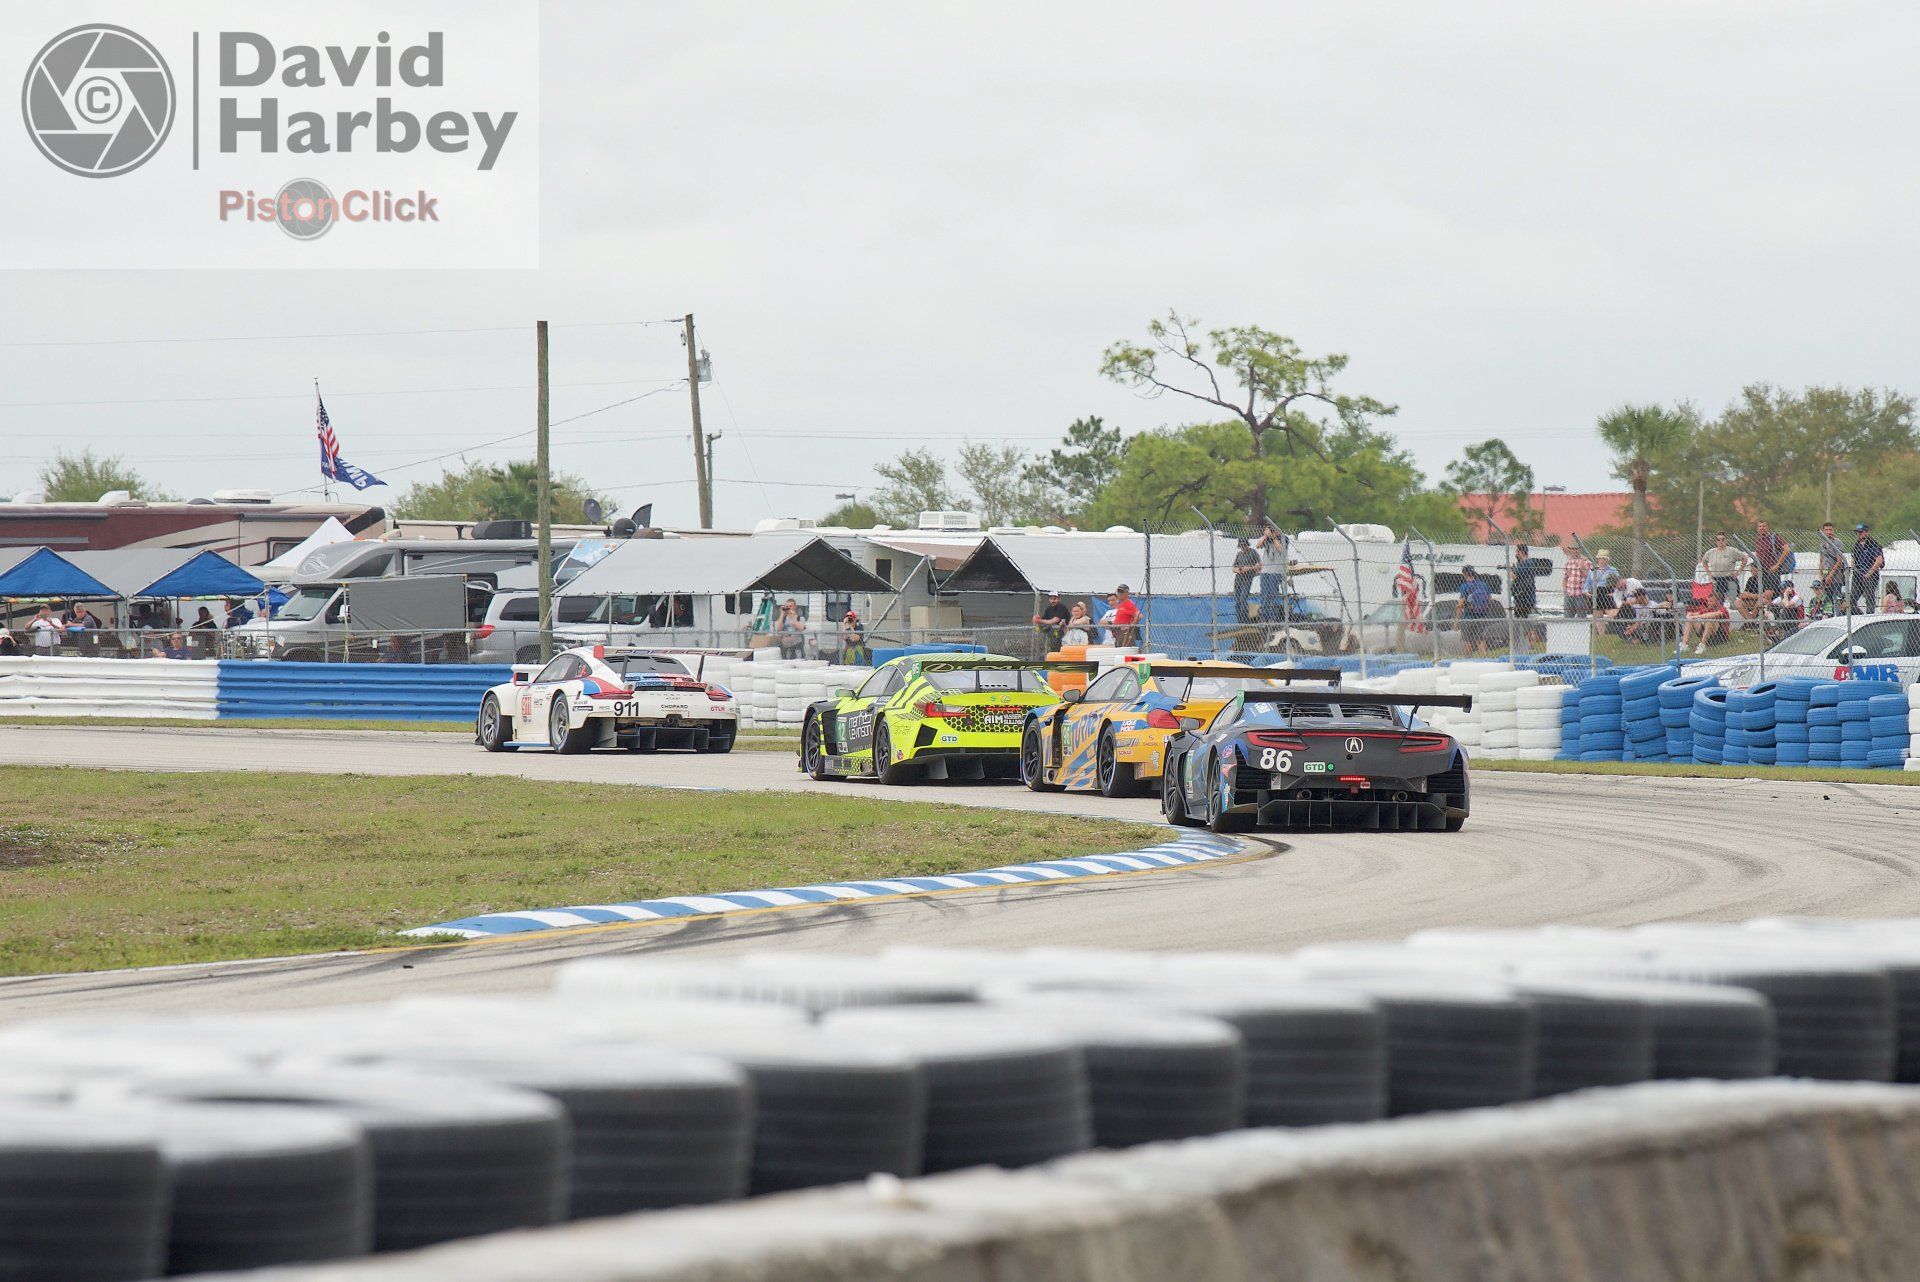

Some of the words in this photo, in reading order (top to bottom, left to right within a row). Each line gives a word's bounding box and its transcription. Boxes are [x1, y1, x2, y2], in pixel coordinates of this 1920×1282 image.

[613, 701, 639, 717] 911
[984, 714, 1004, 725] AIM
[1260, 747, 1293, 773] 86
[1304, 763, 1325, 771] GTD
